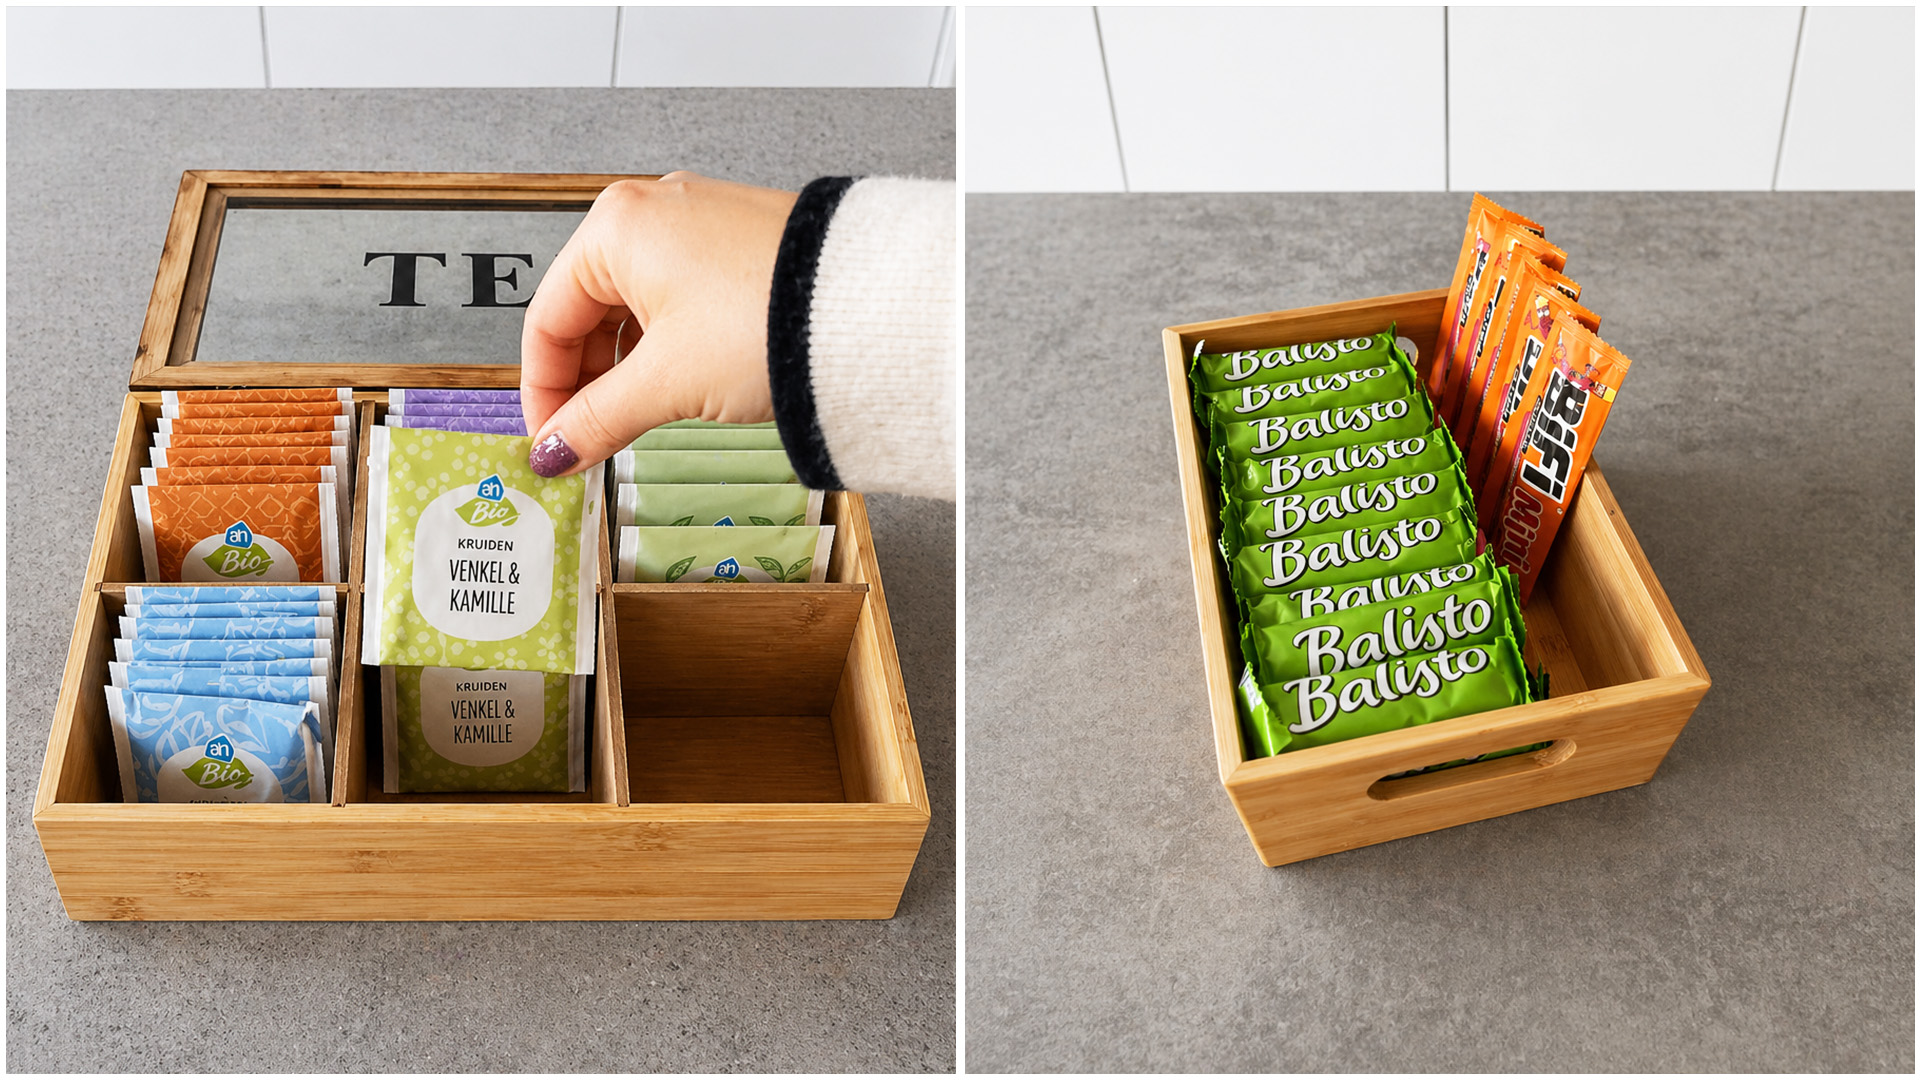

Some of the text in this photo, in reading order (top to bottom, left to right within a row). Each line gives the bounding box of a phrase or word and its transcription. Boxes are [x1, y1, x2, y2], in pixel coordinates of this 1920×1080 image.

[363, 252, 536, 308] TE
[1223, 337, 1375, 381] Balisto
[1234, 367, 1387, 414] Balisto
[1248, 399, 1411, 455] Balisto
[1260, 437, 1427, 494] Balisto
[469, 501, 512, 524] Bio
[1261, 472, 1440, 539] Balisto
[458, 538, 514, 551] KRUIDEN
[1501, 486, 1544, 574] Mini
[220, 549, 263, 574] Bio
[449, 559, 520, 584] VENKEL &
[1259, 517, 1443, 588] Balisto
[449, 588, 516, 615] KAMILLE
[1292, 593, 1494, 677] Balisto
[456, 682, 507, 692] KRUIDEN
[1283, 647, 1490, 734] Balisto
[451, 699, 515, 720] VENKEL &
[454, 723, 513, 744] KAMILLE
[199, 761, 245, 786] Bio
